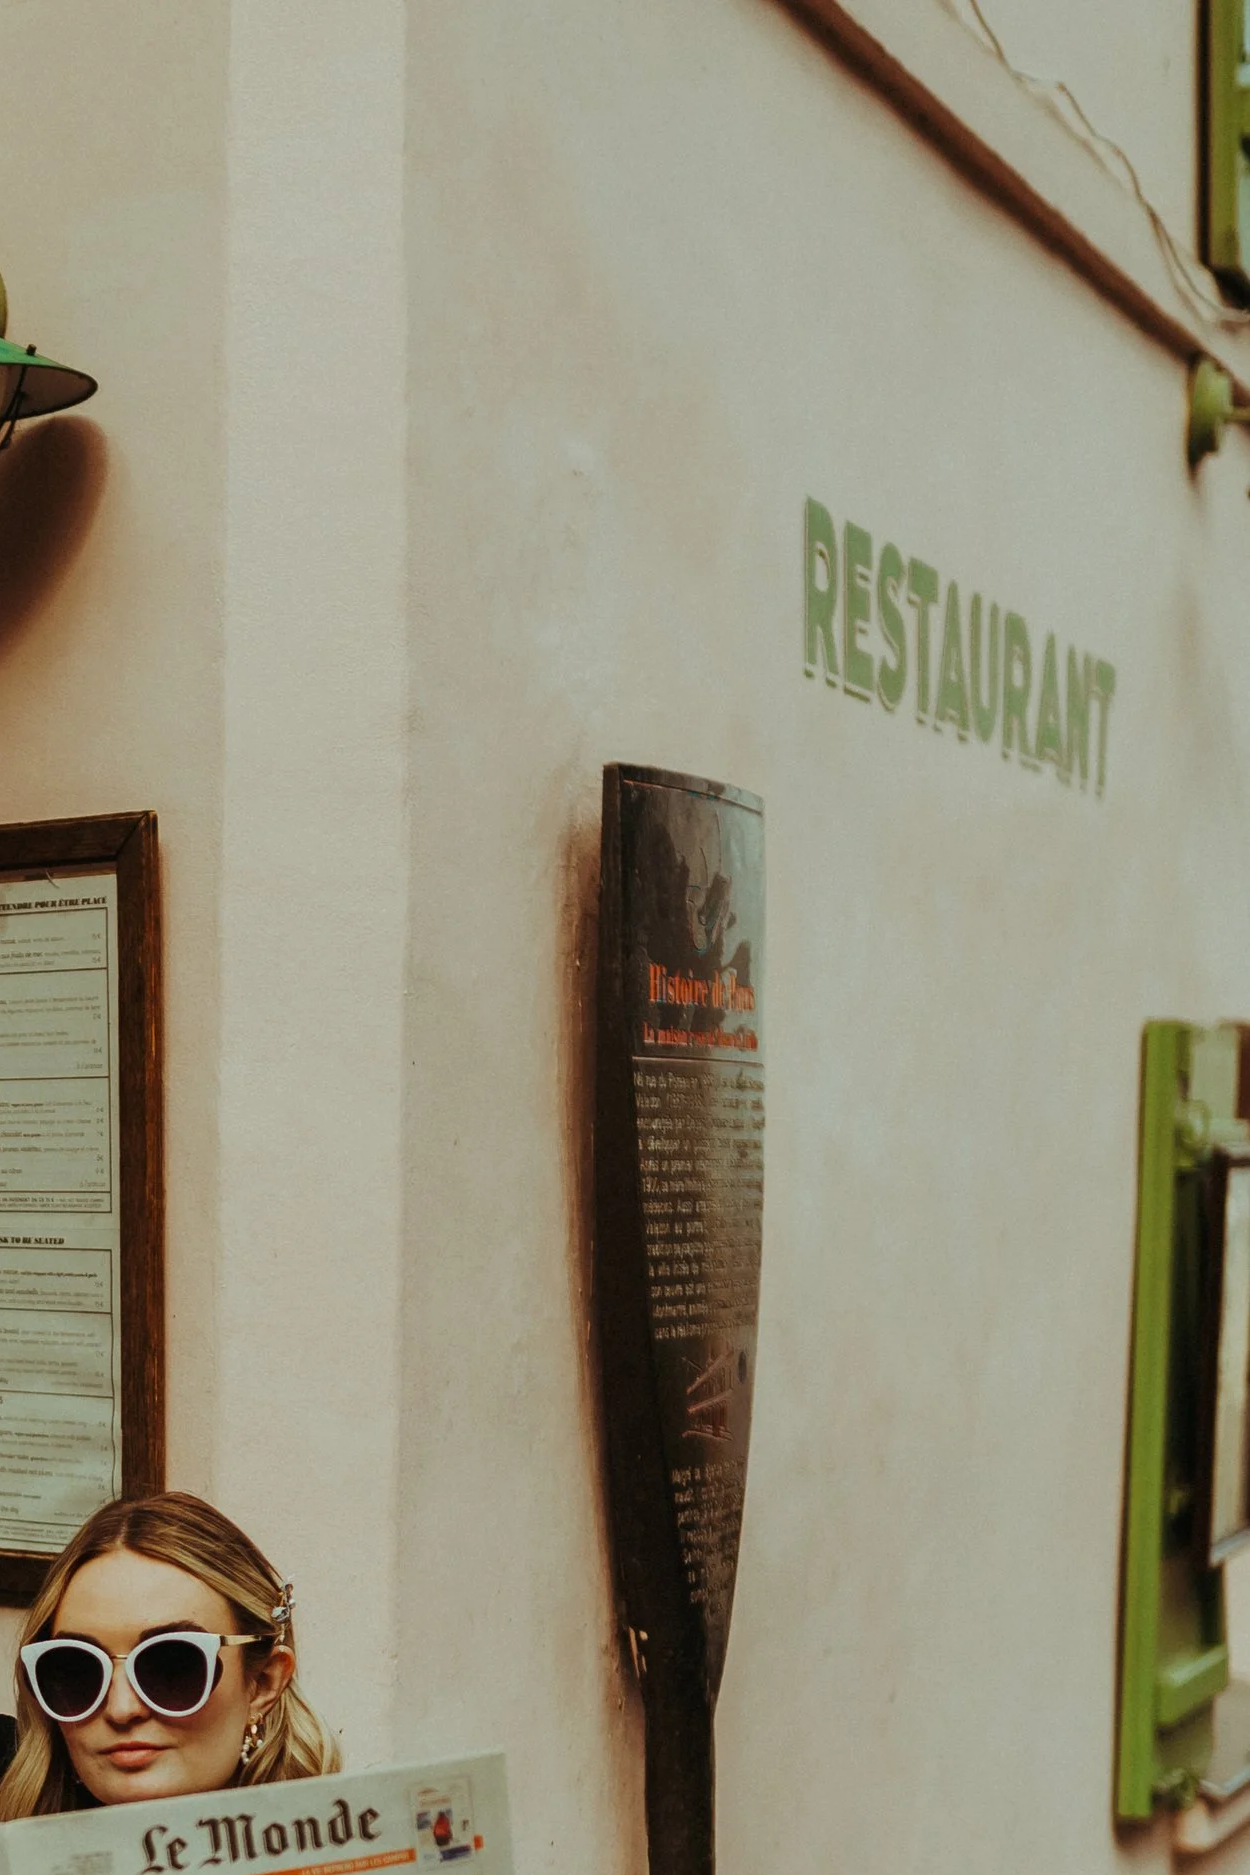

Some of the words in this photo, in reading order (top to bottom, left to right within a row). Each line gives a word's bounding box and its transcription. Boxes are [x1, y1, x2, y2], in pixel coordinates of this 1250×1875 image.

[803, 493, 1116, 800] RESTAURANT
[648, 962, 708, 1008] Histoire
[195, 1797, 383, 1869] Monde
